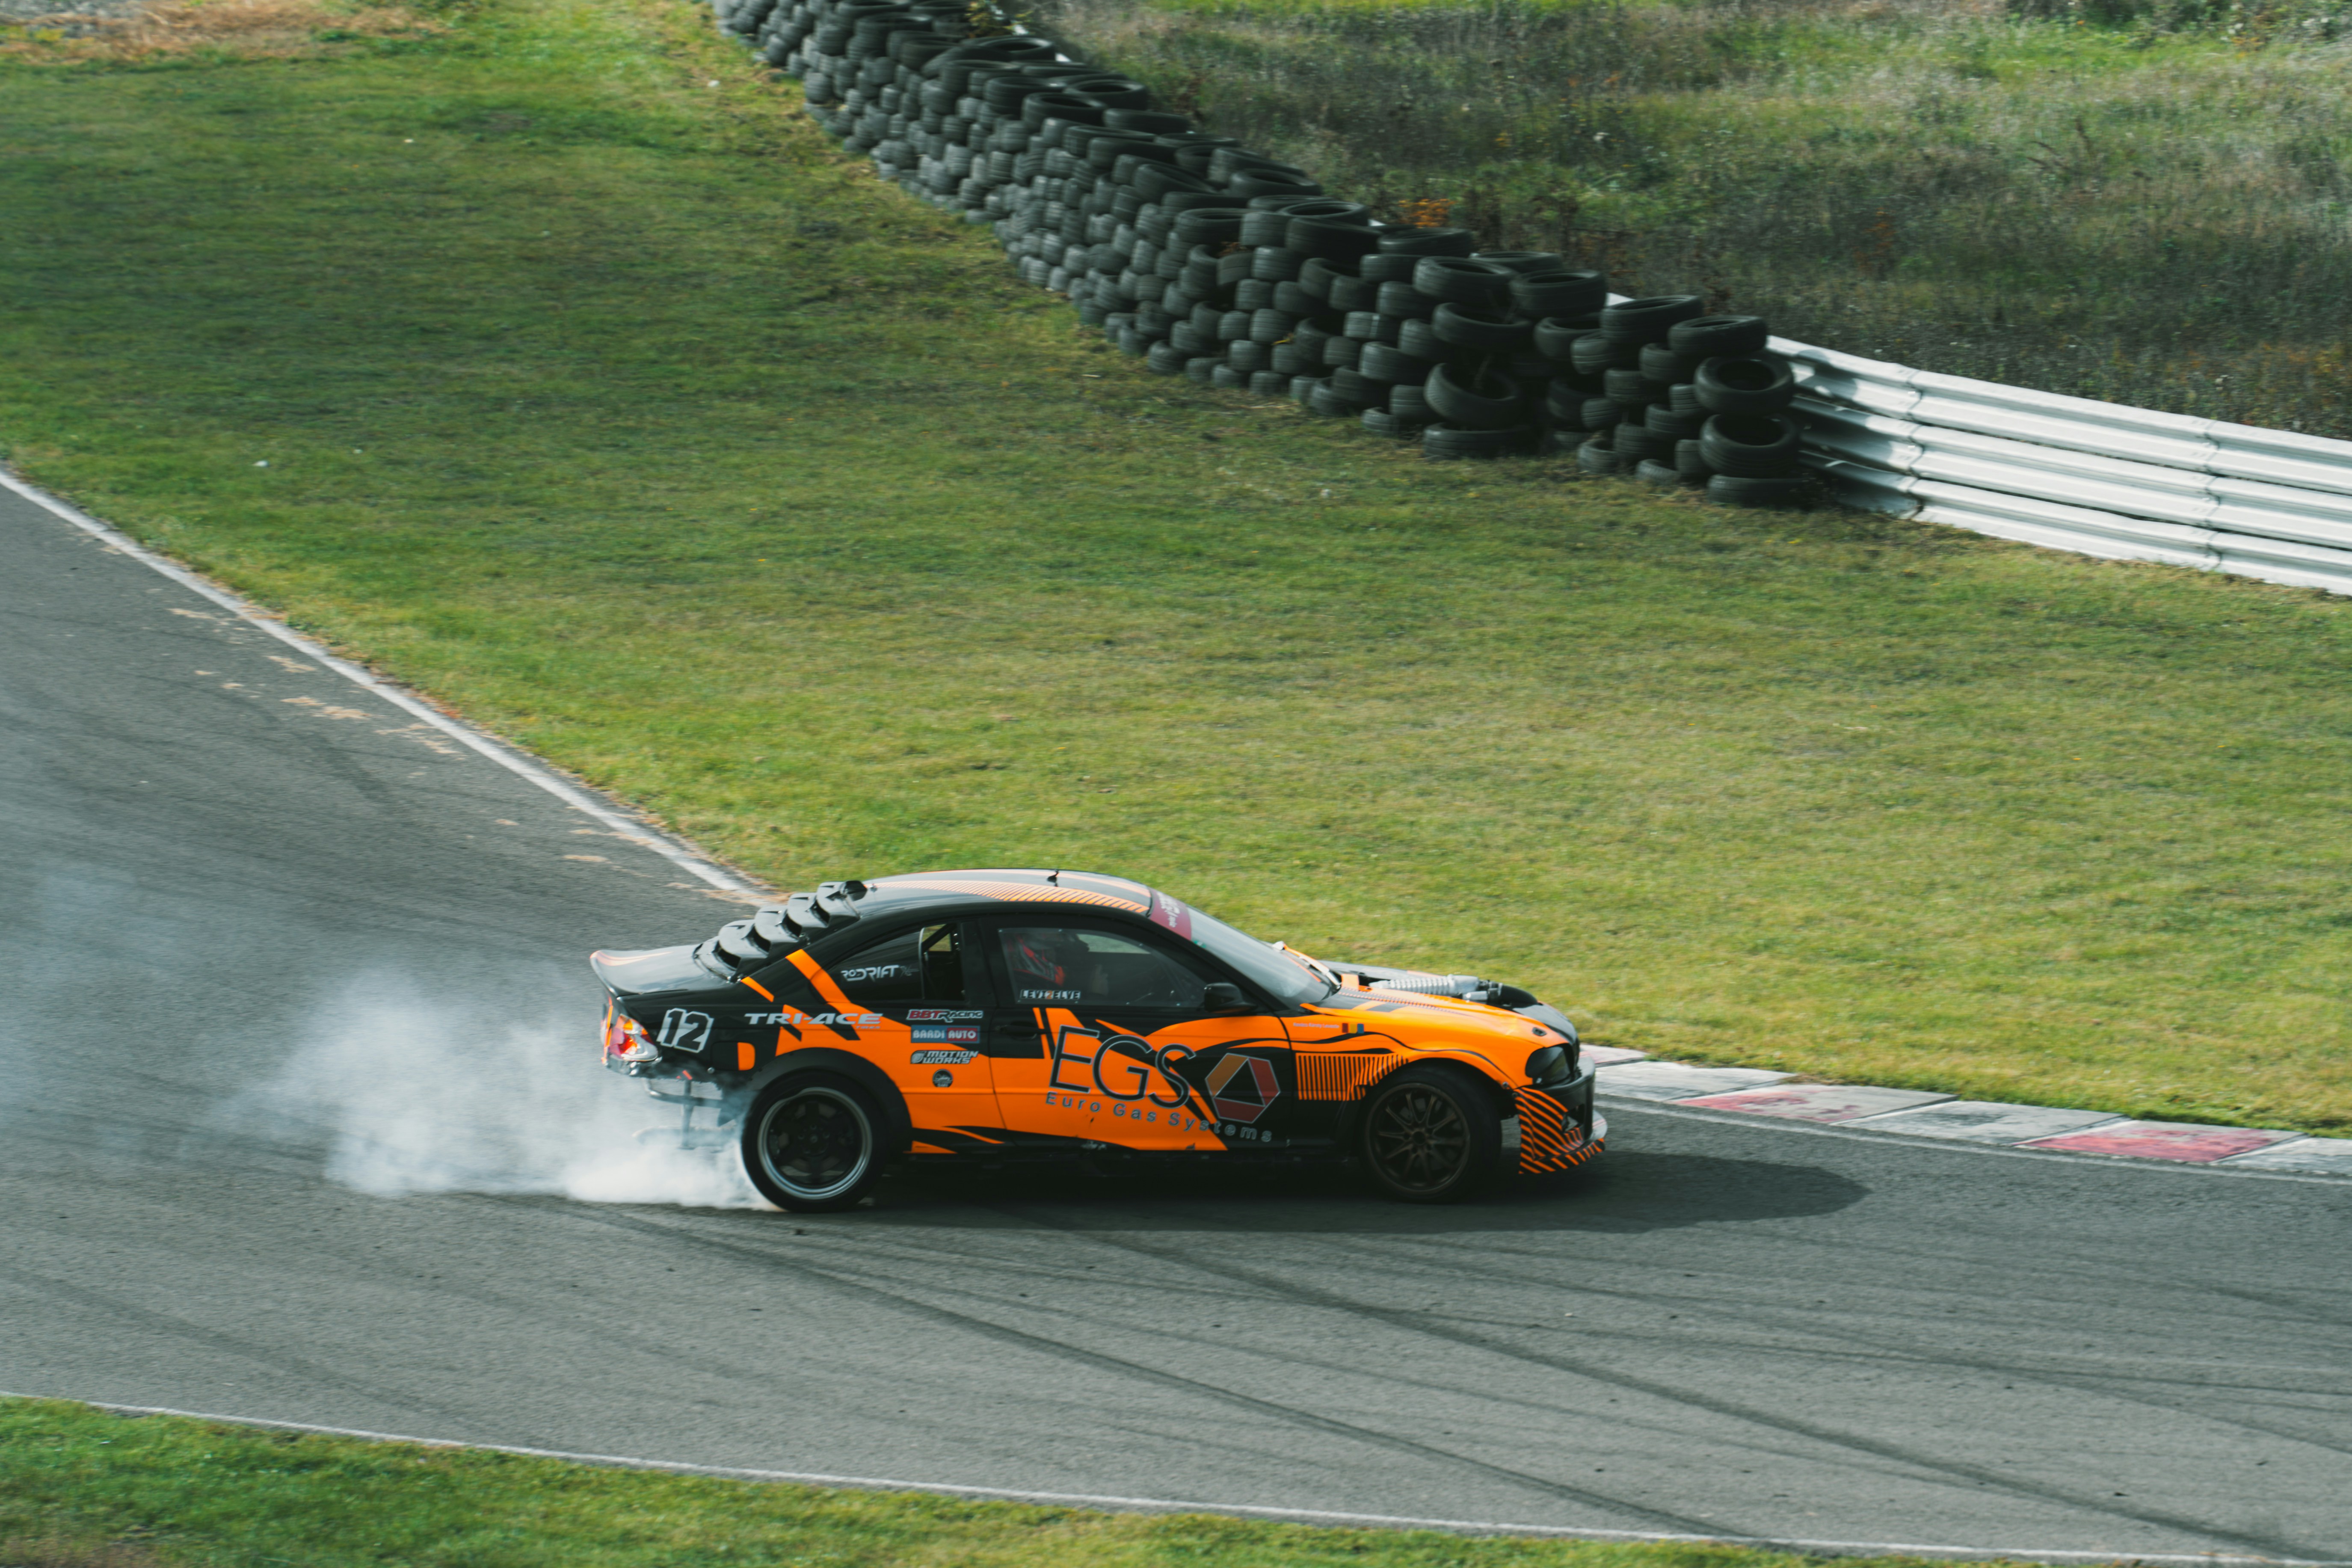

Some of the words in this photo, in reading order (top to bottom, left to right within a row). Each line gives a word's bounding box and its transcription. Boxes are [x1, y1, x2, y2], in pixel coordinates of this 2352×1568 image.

[657, 1008, 714, 1052] 12
[744, 1013, 883, 1025] TRI-ACE
[948, 1030, 976, 1039] AUTO
[1049, 1025, 1196, 1109] EGS
[1045, 1091, 1102, 1113] Euro
[1113, 1103, 1157, 1123] Gas
[1168, 1112, 1273, 1142] Systems
